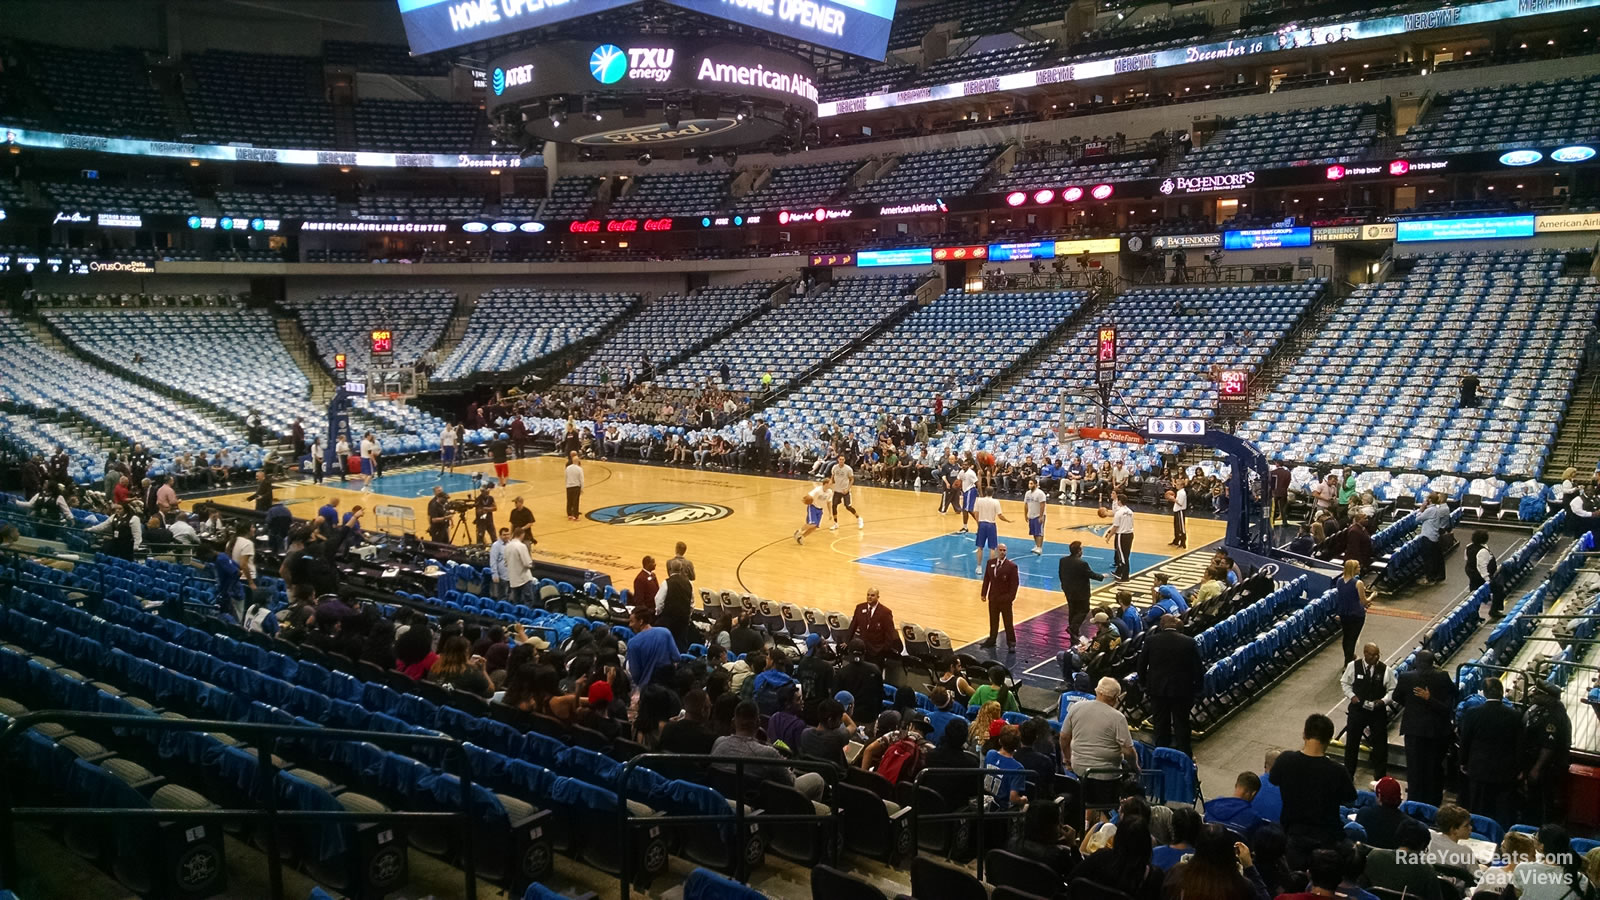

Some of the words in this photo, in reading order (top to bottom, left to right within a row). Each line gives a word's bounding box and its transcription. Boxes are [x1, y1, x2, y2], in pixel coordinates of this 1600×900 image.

[449, 0, 500, 31] HOME
[779, 0, 846, 36] OPENER
[1403, 8, 1460, 31] MERCYME
[628, 48, 674, 68] TXU
[1186, 41, 1246, 63] December
[1249, 41, 1263, 54] 16
[1114, 54, 1157, 73] MERCYME
[505, 64, 534, 88] AT&T
[628, 68, 672, 82] energy
[698, 58, 790, 92] American
[458, 154, 508, 168] December
[509, 158, 521, 168] 16
[1418, 162, 1431, 170] the
[1432, 160, 1448, 168] box
[1177, 172, 1255, 189] BACHENDORF'S
[880, 206, 912, 216] American
[912, 204, 937, 213] Airlines
[1313, 227, 1359, 235] EXPERIENCE
[90, 261, 132, 272] CyrusOne
[374, 340, 389, 351] 24
[1226, 381, 1241, 394] 24
